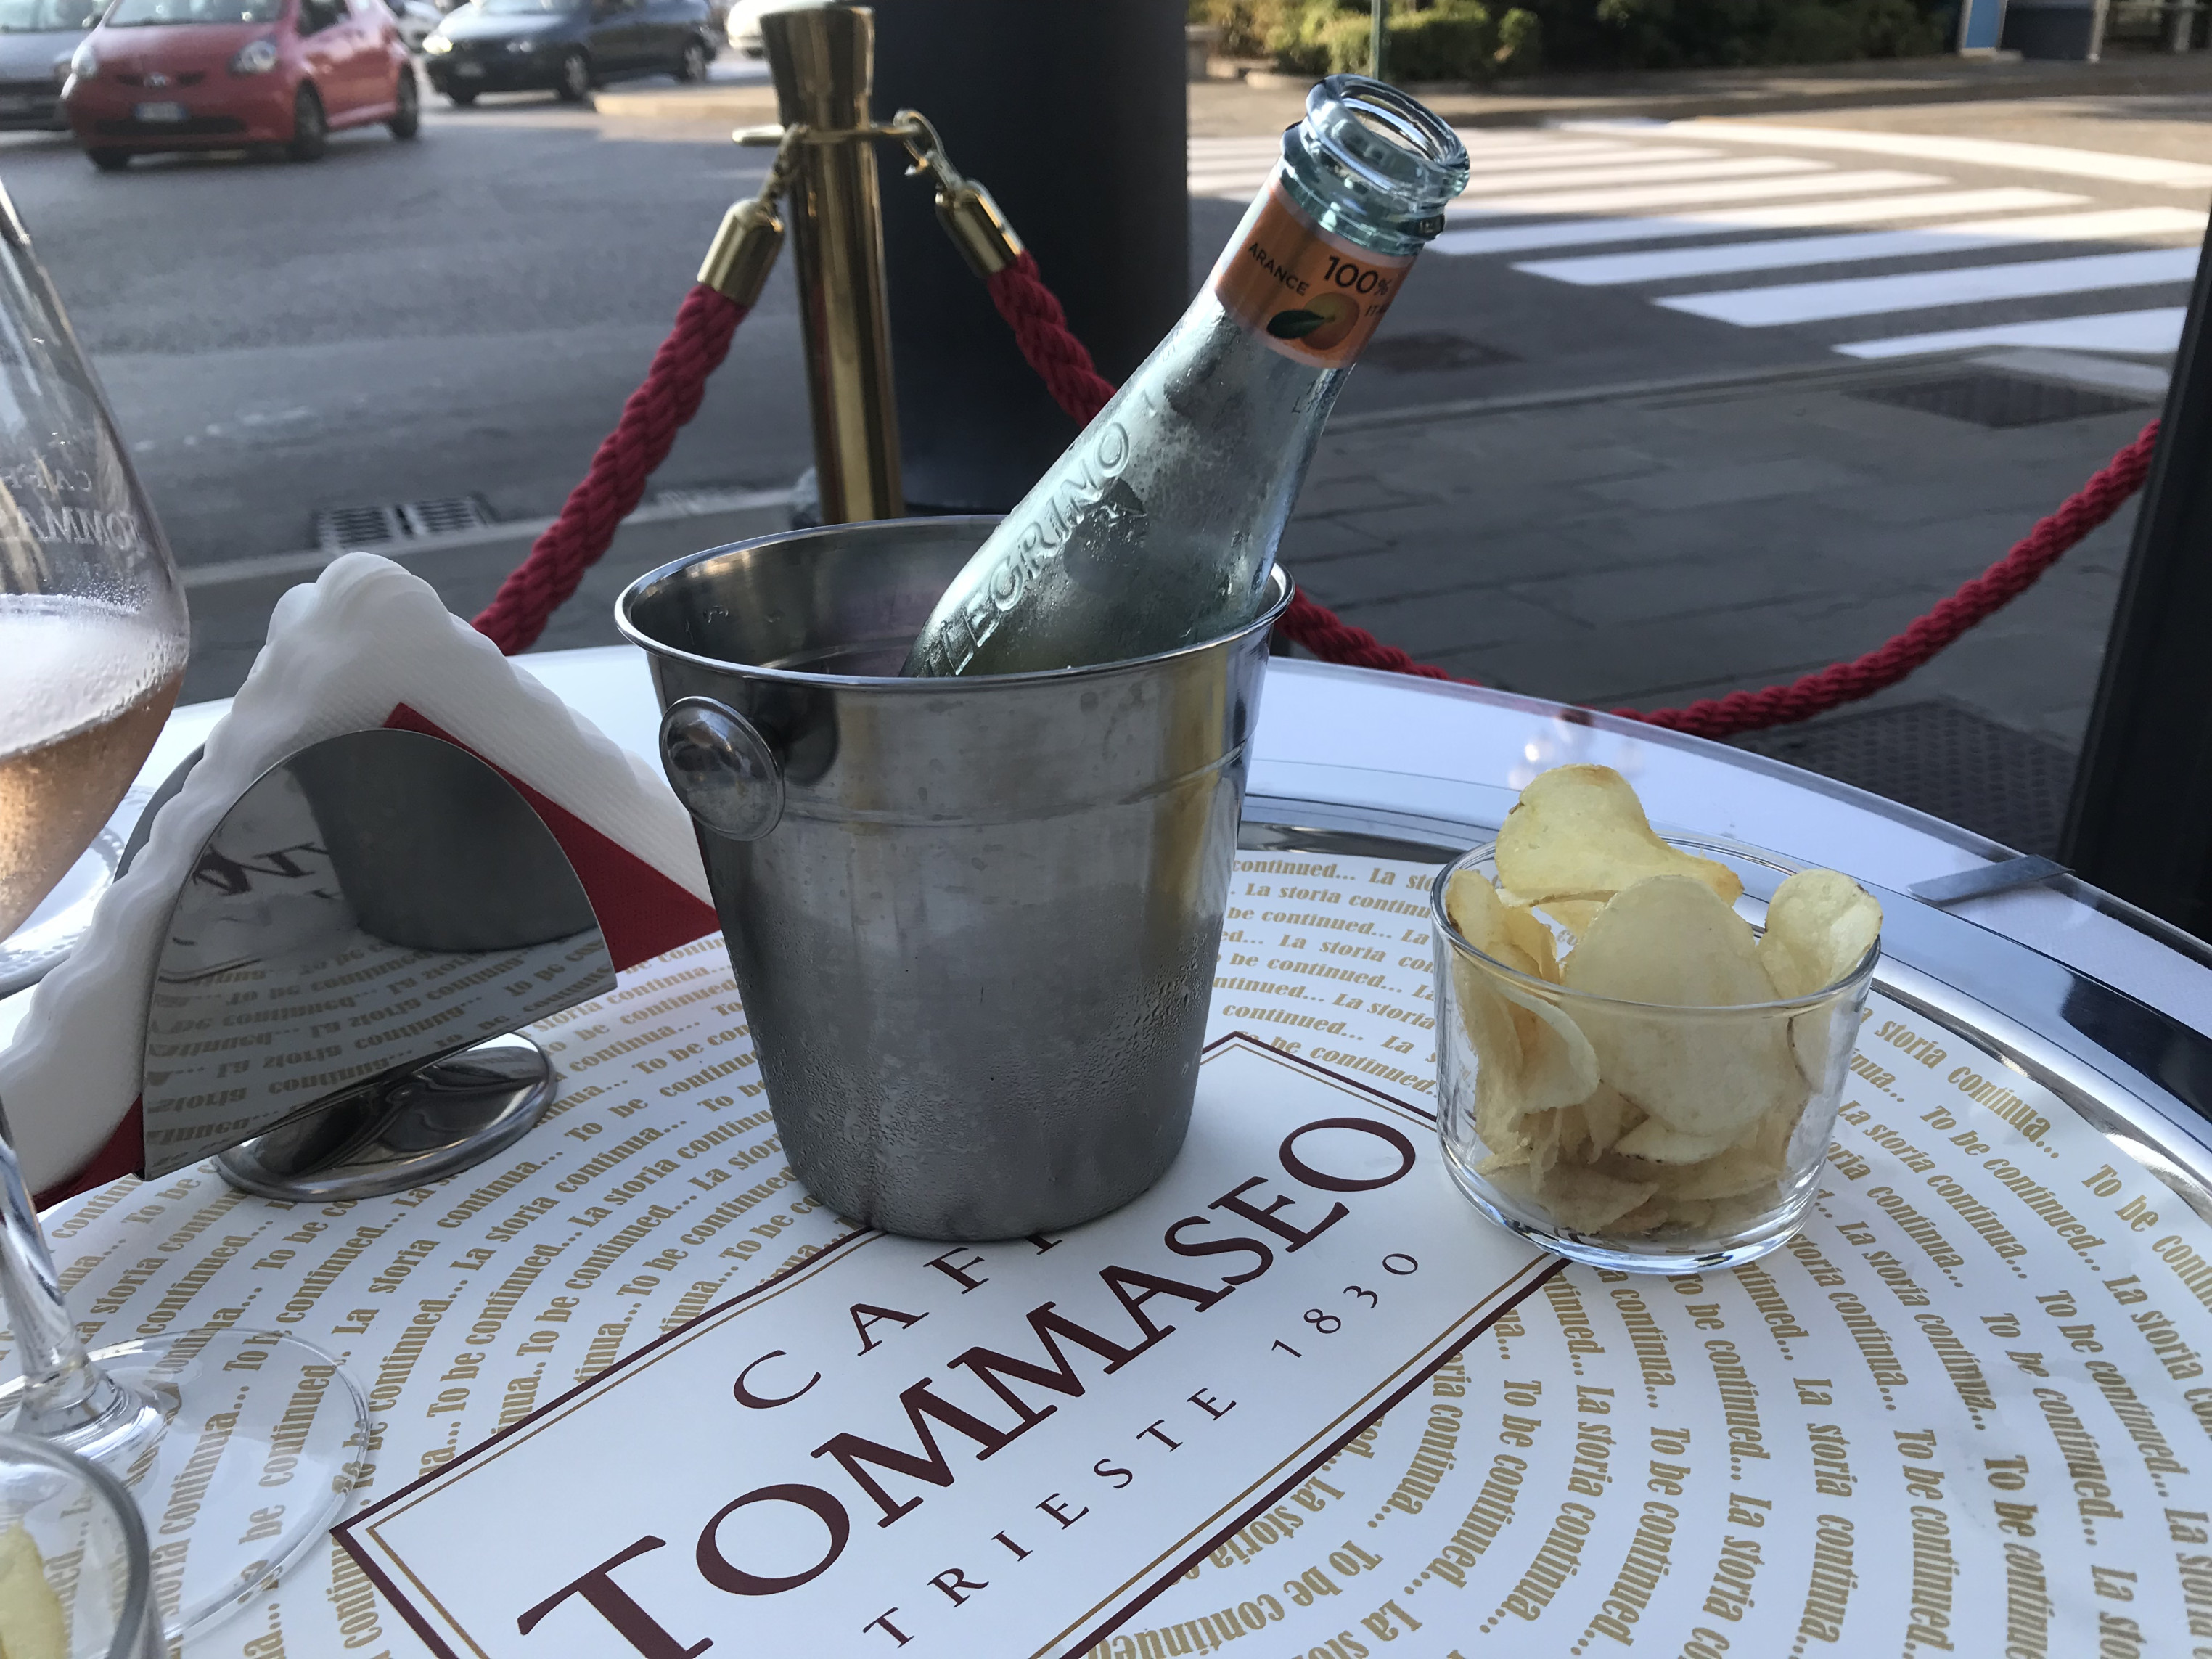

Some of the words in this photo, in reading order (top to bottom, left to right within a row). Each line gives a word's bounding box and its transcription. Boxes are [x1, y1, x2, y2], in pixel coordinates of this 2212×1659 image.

[1248, 242, 1309, 296] ARANCE
[1324, 255, 1393, 296] 100%
[1245, 883, 1271, 897] La
[1278, 886, 1341, 904] storia
[1369, 867, 1396, 885] La
[1227, 906, 1255, 919] be
[1261, 912, 1392, 938] continued...
[1400, 929, 1430, 945] La
[1279, 934, 1307, 949] La
[1319, 941, 1386, 962] storia
[1229, 953, 1259, 967] be
[1267, 959, 1402, 993] continued...
[574, 1025, 610, 1041] be
[1222, 1005, 1364, 1041] continued...
[1380, 1035, 1414, 1054] La
[1332, 993, 1364, 1010] La
[1367, 1003, 1435, 1030] storia
[569, 1022, 700, 1072] continua...
[711, 1001, 743, 1016] To
[631, 1058, 668, 1074] To
[666, 1043, 704, 1062] be
[1874, 1020, 1947, 1069] storia
[1947, 1066, 2059, 1159] continua...
[2081, 1163, 2122, 1197] To
[2114, 1195, 2166, 1232] be
[121, 1205, 165, 1224] To
[155, 1179, 199, 1200] be
[449, 1248, 497, 1271] La
[485, 1197, 560, 1242] storia
[555, 1121, 687, 1193] continua...
[697, 1096, 734, 1112] To
[604, 1159, 681, 1205] storia
[687, 1168, 732, 1192] La
[331, 1308, 380, 1335] La
[367, 1240, 441, 1293] storia
[436, 1152, 563, 1229] continua...
[564, 1123, 603, 1142] To
[607, 1099, 649, 1118] be
[567, 1205, 613, 1228] La
[718, 1240, 762, 1261] To
[749, 1215, 795, 1240] be
[1836, 1221, 1877, 1246] La
[250, 1249, 296, 1270] To
[282, 1221, 329, 1244] be
[565, 1195, 697, 1290] continued...
[1920, 1105, 1957, 1130] To
[1949, 1130, 1991, 1156] be
[1983, 1158, 2105, 1271] continued...
[2102, 1274, 2148, 1306] La
[2131, 1310, 2204, 1381] storia
[90, 1258, 168, 1314] storia
[136, 1221, 273, 1334] continued...
[465, 1232, 583, 1345] continued...
[616, 1275, 660, 1296] To
[642, 1248, 689, 1271] be
[1863, 1250, 1930, 1306] storia
[534, 1296, 580, 1323] be
[1685, 1303, 1725, 1330] be
[1838, 1099, 1871, 1126] La
[1862, 1124, 1936, 1173] storia
[1926, 1175, 2028, 1279] continua...
[2036, 1290, 2078, 1317] To
[2057, 1324, 2104, 1353] be
[2083, 1360, 2189, 1498] continued...
[2163, 1507, 2210, 1545] La
[158, 1385, 250, 1535] continua...
[223, 1351, 268, 1371] To
[276, 1213, 406, 1323] continued...
[391, 1187, 436, 1208] La
[369, 1279, 468, 1412] continued...
[515, 1330, 560, 1356] To
[1610, 1289, 1676, 1409] continua...
[1828, 1292, 1909, 1411] continua...
[439, 1352, 486, 1382] be
[517, 1117, 1416, 1659] TOMMASEO
[1914, 1314, 1997, 1431] continua...
[426, 1388, 470, 1418] To
[1504, 1380, 1542, 1407] To
[1576, 1385, 1615, 1414] La
[1704, 1340, 1771, 1481] continued...
[1793, 1377, 1833, 1406] La
[1867, 1187, 1965, 1288] continua...
[1980, 1313, 2021, 1338] To
[2006, 1351, 2053, 1377] be
[2032, 1387, 2124, 1547] continued...
[2090, 1565, 2138, 1602] La
[863, 1388, 1237, 1648] TRIESTE
[1271, 1253, 1418, 1360] 1830
[1499, 1413, 1542, 1448] be
[1650, 1426, 1691, 1455] To
[1893, 1428, 1938, 1459] To
[1367, 1404, 1464, 1528] continua...
[1567, 1422, 1617, 1497] storia
[1647, 1459, 1691, 1496] be
[1806, 1422, 1858, 1497] storia
[1983, 1454, 2030, 1491] To
[1291, 1476, 1345, 1512] La
[1902, 1465, 1945, 1501] be
[238, 1505, 285, 1545] be
[1404, 1454, 1528, 1595] continued...
[1727, 1492, 1772, 1528] La
[1993, 1500, 2039, 1538] be
[1328, 1540, 1384, 1576] To
[1479, 1502, 1596, 1634] continua...
[1570, 1501, 1679, 1656] continued...
[1702, 1535, 1765, 1622] storia
[1283, 1565, 1343, 1607] be
[1360, 1599, 1423, 1642] La
